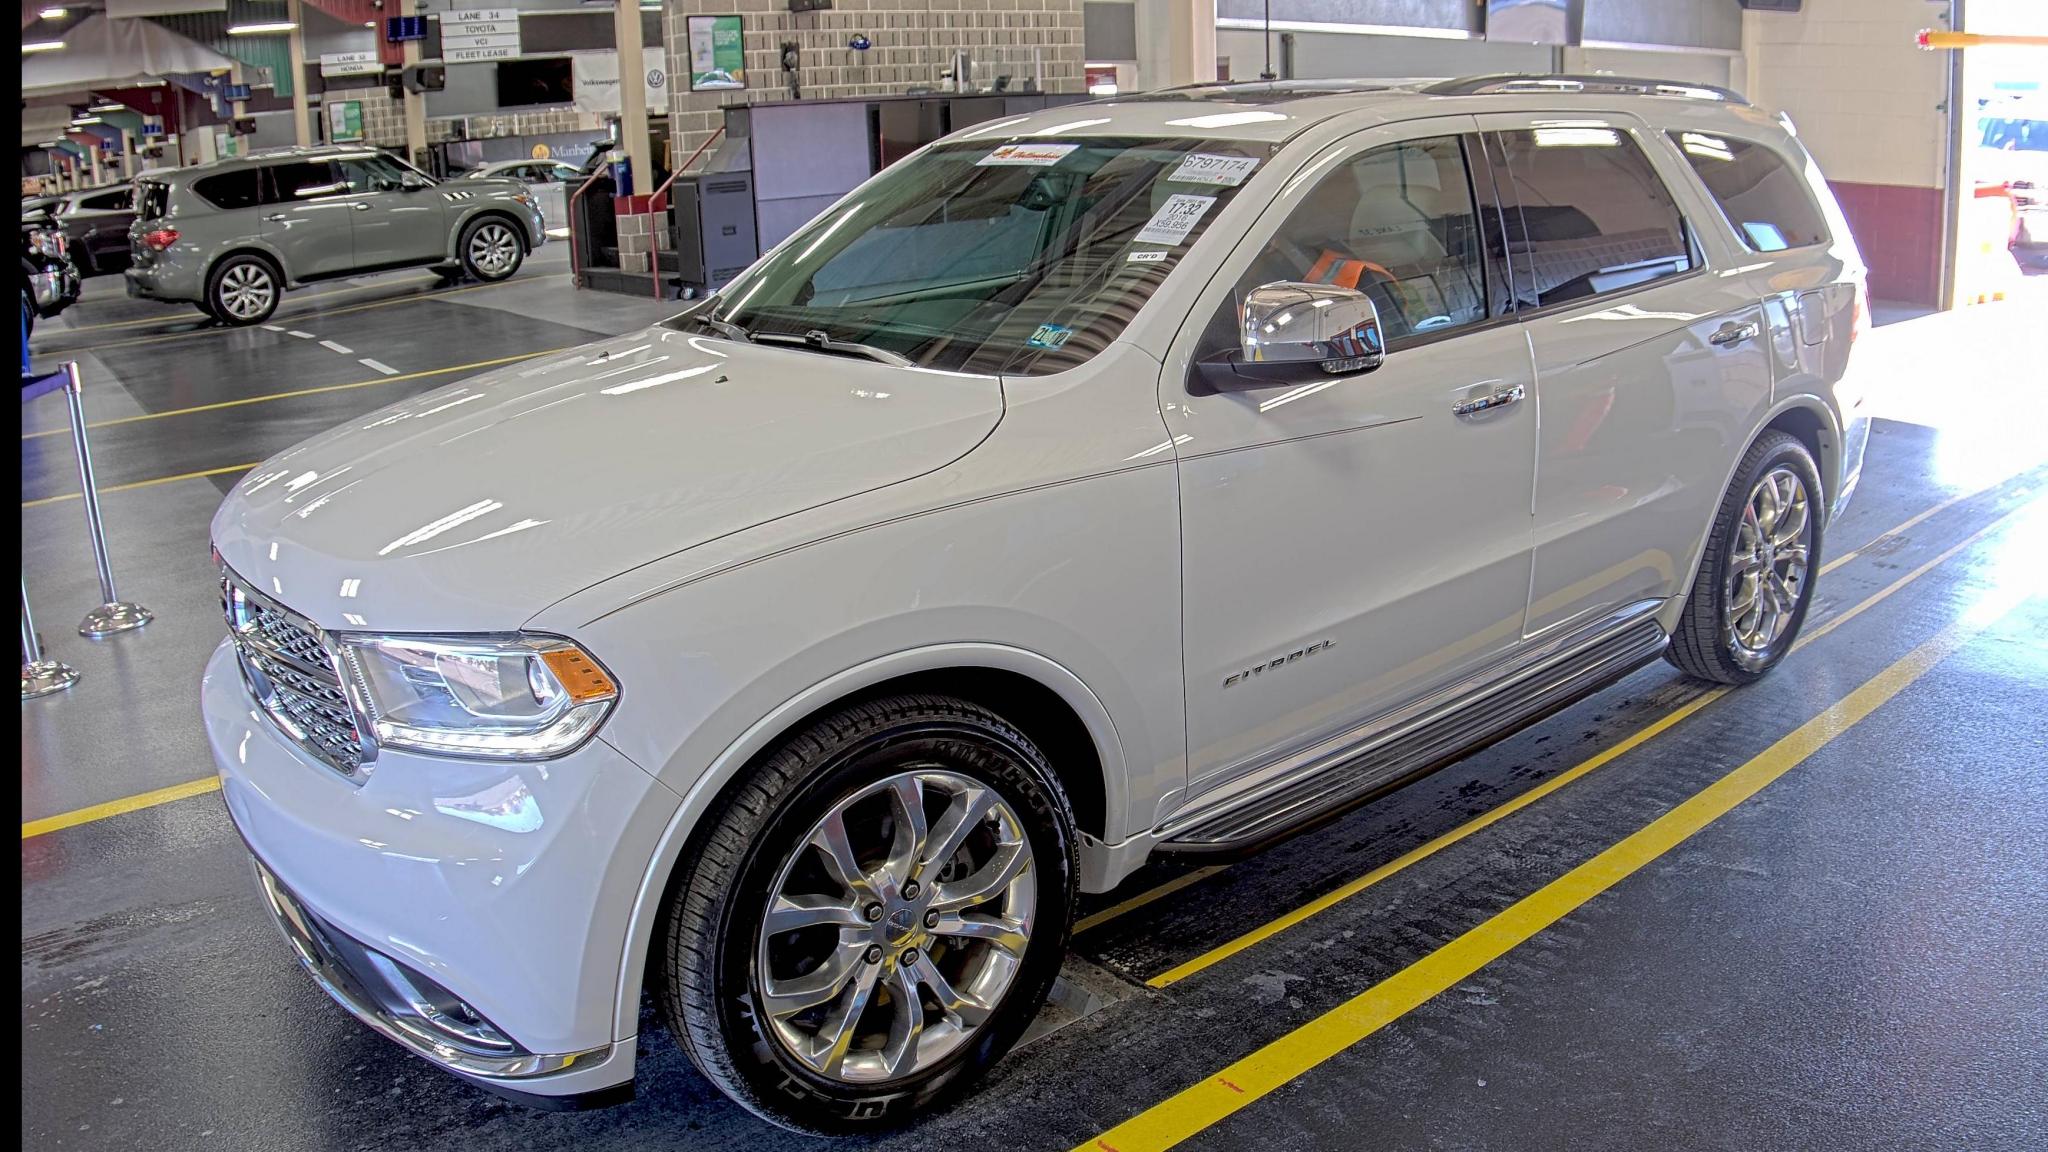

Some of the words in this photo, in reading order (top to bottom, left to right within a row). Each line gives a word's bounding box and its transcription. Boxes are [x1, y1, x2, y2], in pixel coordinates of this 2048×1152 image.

[458, 11, 481, 20] LANE
[488, 11, 500, 19] 34
[464, 25, 496, 34] TOYOTA
[474, 38, 488, 46] VCI
[455, 51, 481, 59] FLEET
[482, 50, 508, 58] LEASE
[552, 143, 593, 158] Manhei
[1183, 152, 1249, 171] 6797174
[1223, 640, 1336, 688] CITADEL
